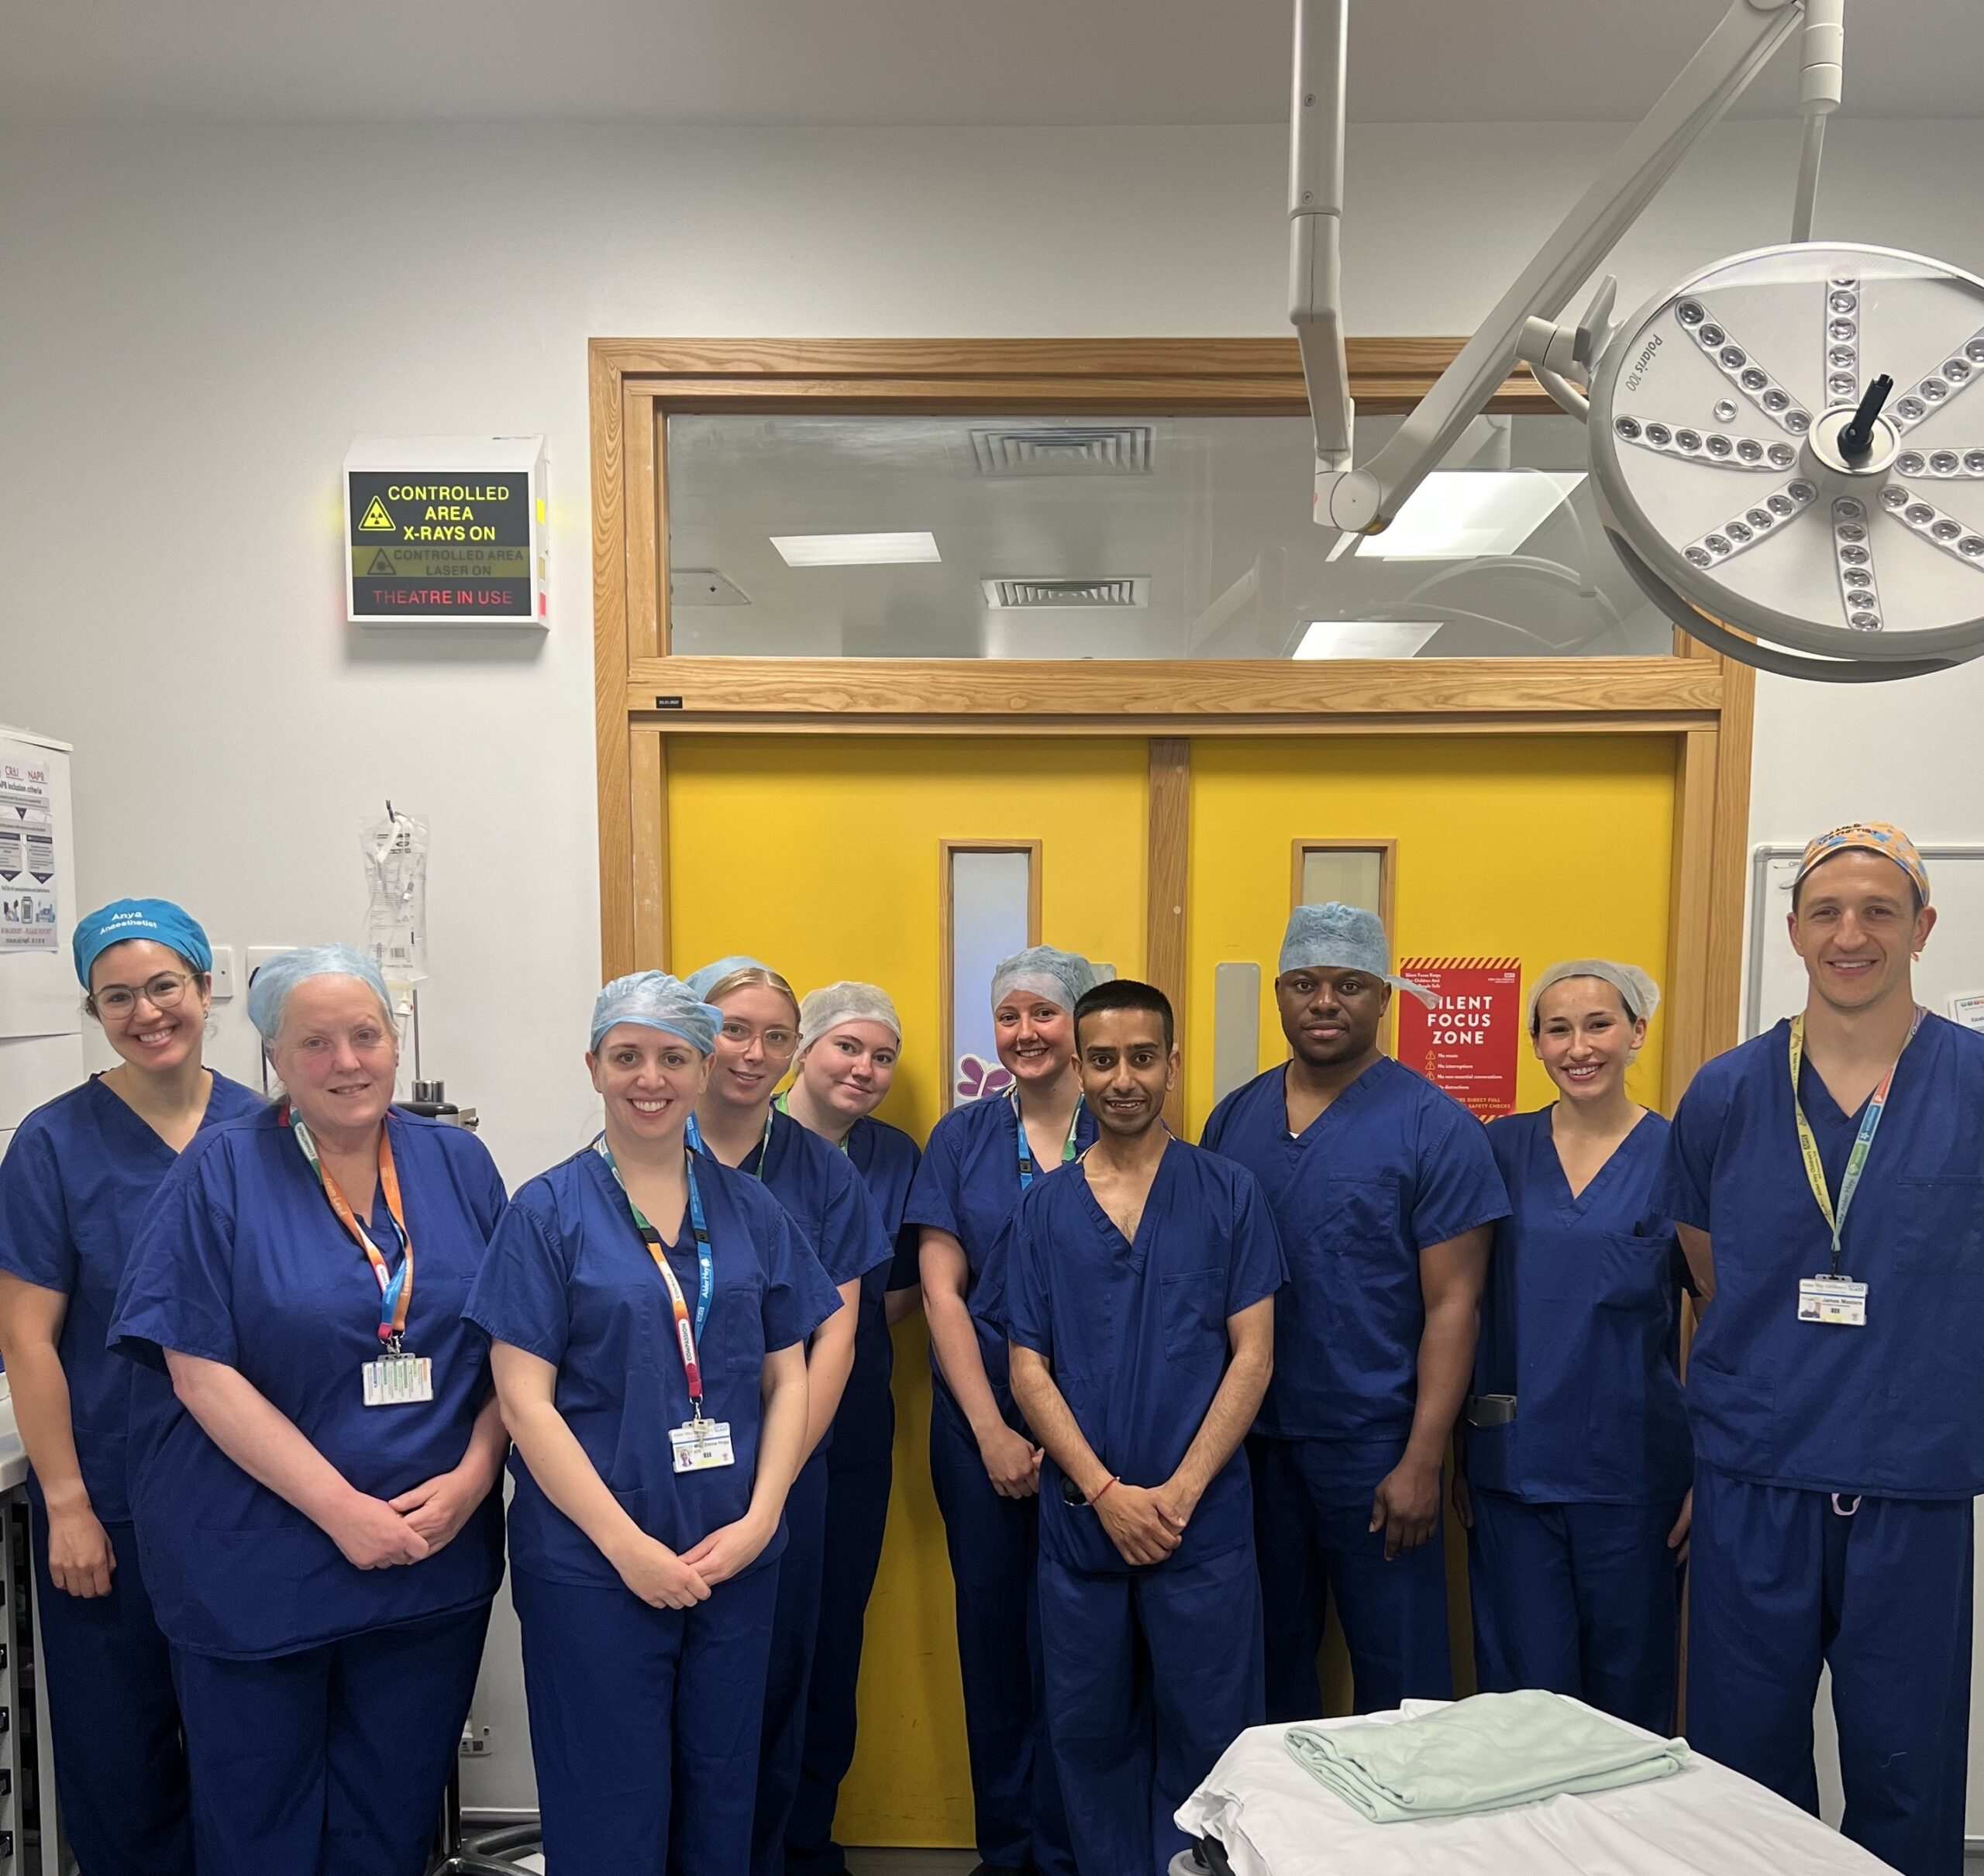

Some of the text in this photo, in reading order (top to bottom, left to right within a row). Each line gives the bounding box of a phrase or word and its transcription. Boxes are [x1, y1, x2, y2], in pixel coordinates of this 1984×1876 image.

[1625, 333, 1663, 391] Polaris 100
[388, 486, 509, 501] CONTROLLED
[425, 506, 474, 521] AREA
[404, 525, 495, 540] X-RAYS ON
[393, 549, 524, 560] CONTROLLED AREA
[426, 565, 491, 576] LASER ON
[373, 590, 513, 604] THEATRE IN USE
[112, 911, 143, 921] Anya
[99, 919, 158, 935] Anaesthetist
[1436, 996, 1493, 1010] ILENT
[1427, 1014, 1491, 1027] FOCUS
[1432, 1031, 1484, 1045] ZONE
[297, 1125, 315, 1157] COMMITMENT
[333, 1197, 348, 1217] Lead
[701, 1266, 711, 1280] Hey
[682, 1323, 692, 1361] COMPASSION
